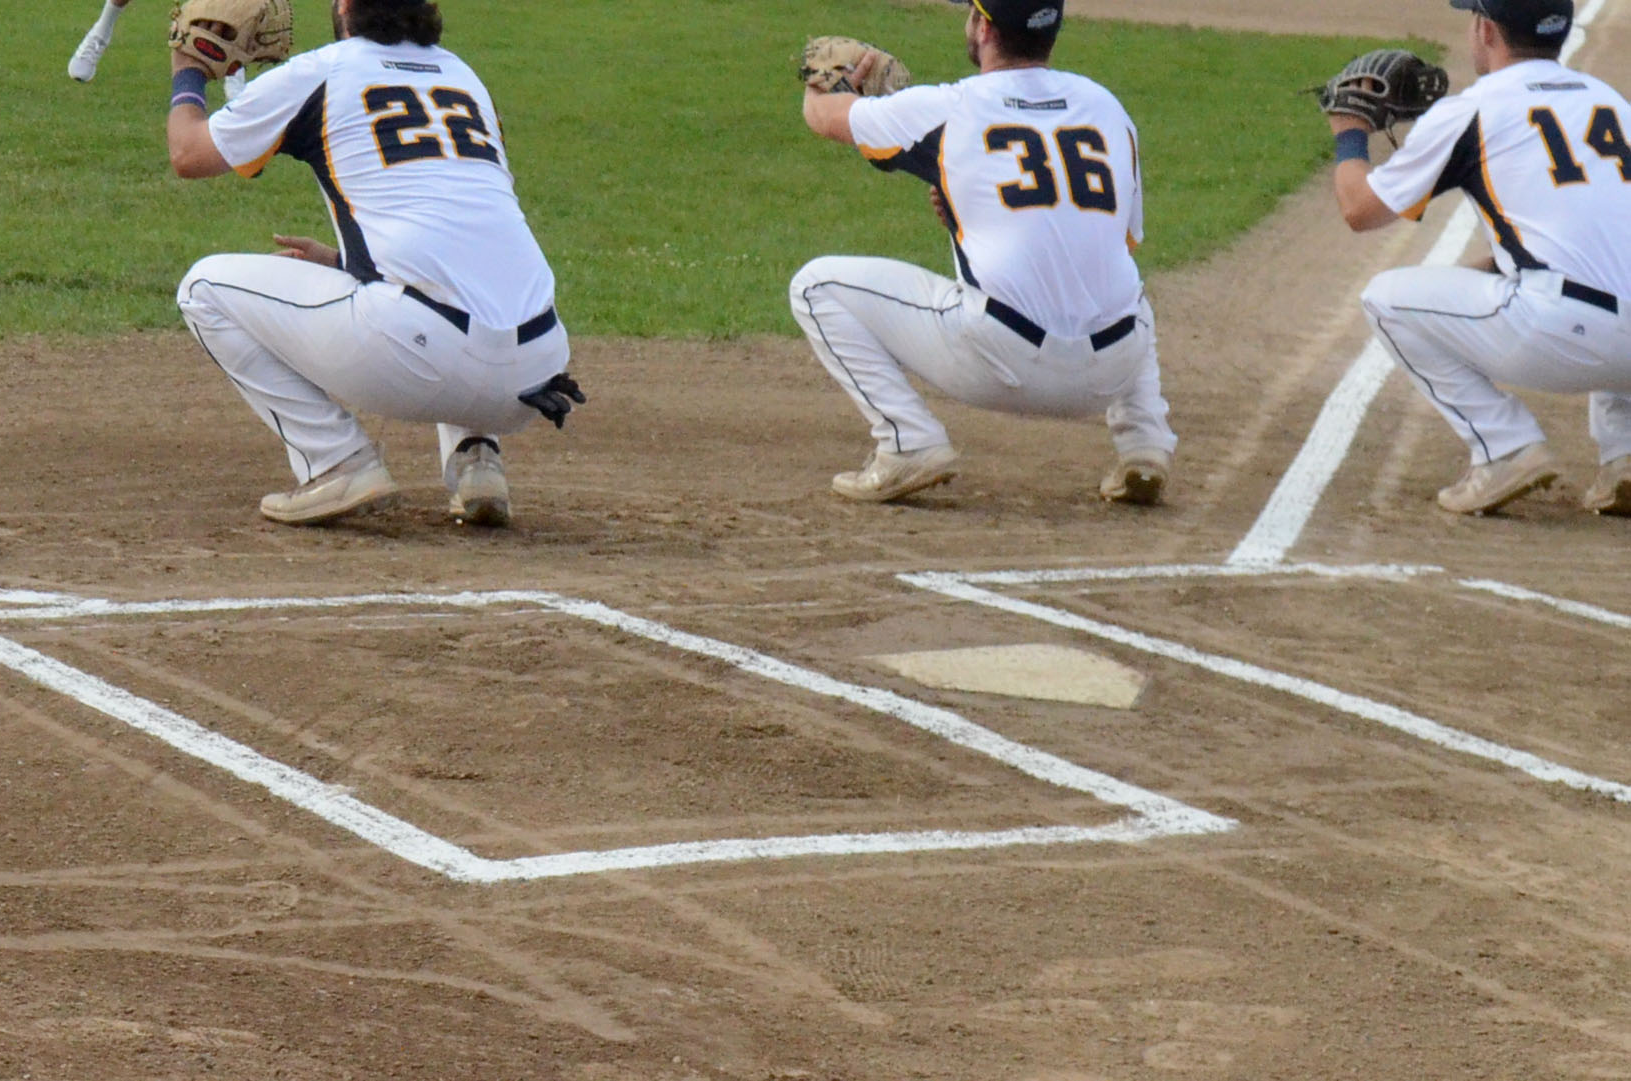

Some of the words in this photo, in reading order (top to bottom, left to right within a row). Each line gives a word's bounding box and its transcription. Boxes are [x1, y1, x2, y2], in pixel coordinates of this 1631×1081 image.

[361, 84, 503, 169] 22
[1527, 105, 1631, 188] 14
[982, 123, 1117, 216] 36
